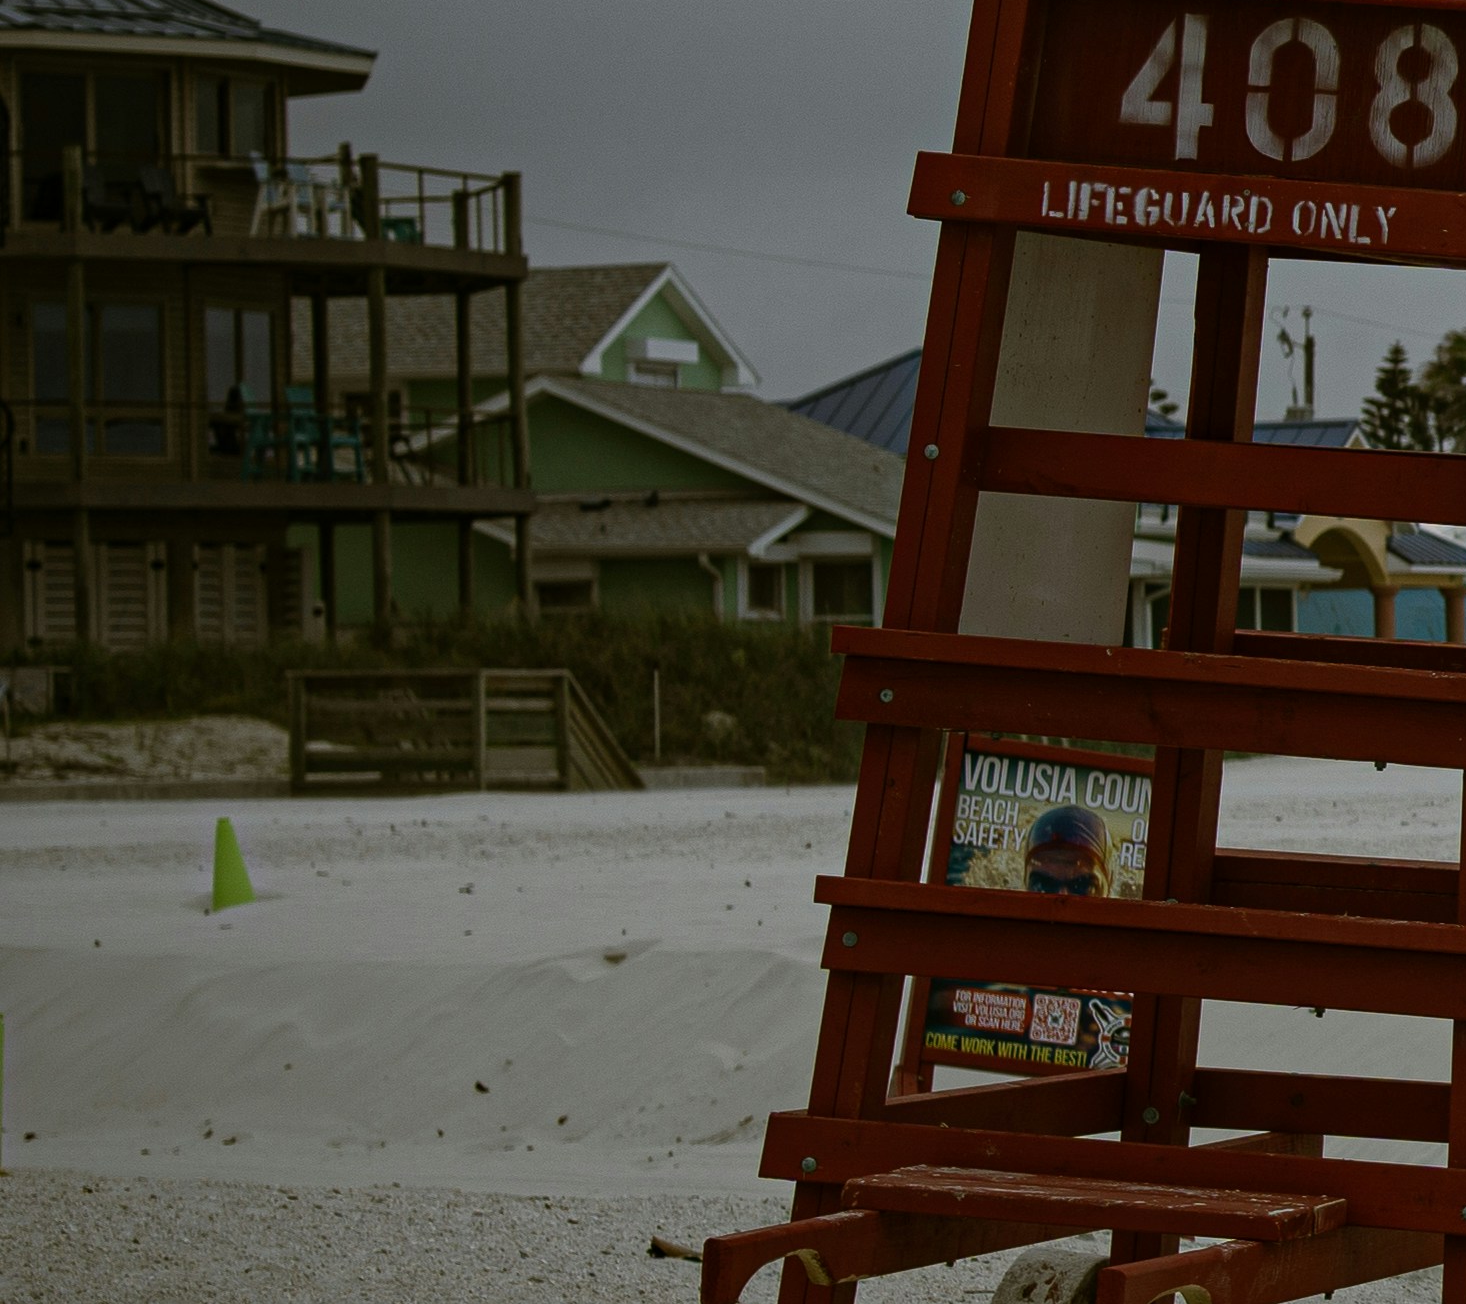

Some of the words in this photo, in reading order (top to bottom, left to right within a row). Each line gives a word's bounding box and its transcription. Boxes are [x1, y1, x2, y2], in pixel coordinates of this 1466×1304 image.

[1118, 13, 1459, 169] 408
[1041, 180, 1273, 235] LIFEGUARD
[1292, 199, 1397, 245] ONLY
[964, 752, 1078, 806] VOLUSIA
[1085, 770, 1151, 814] COUN
[957, 794, 1019, 826] BEACH
[953, 819, 1026, 851] SAFETY
[953, 1000, 973, 1014] VISIT
[955, 988, 972, 1001] FOR
[973, 992, 1027, 1009] INFORMATION
[965, 1013, 977, 1026] OR
[978, 1016, 1000, 1030] SCAN
[925, 1032, 958, 1051] COME
[961, 1035, 996, 1055] WORK
[997, 1041, 1028, 1060] WITH
[1030, 1045, 1052, 1064] THE
[1053, 1050, 1088, 1068] BEST!
